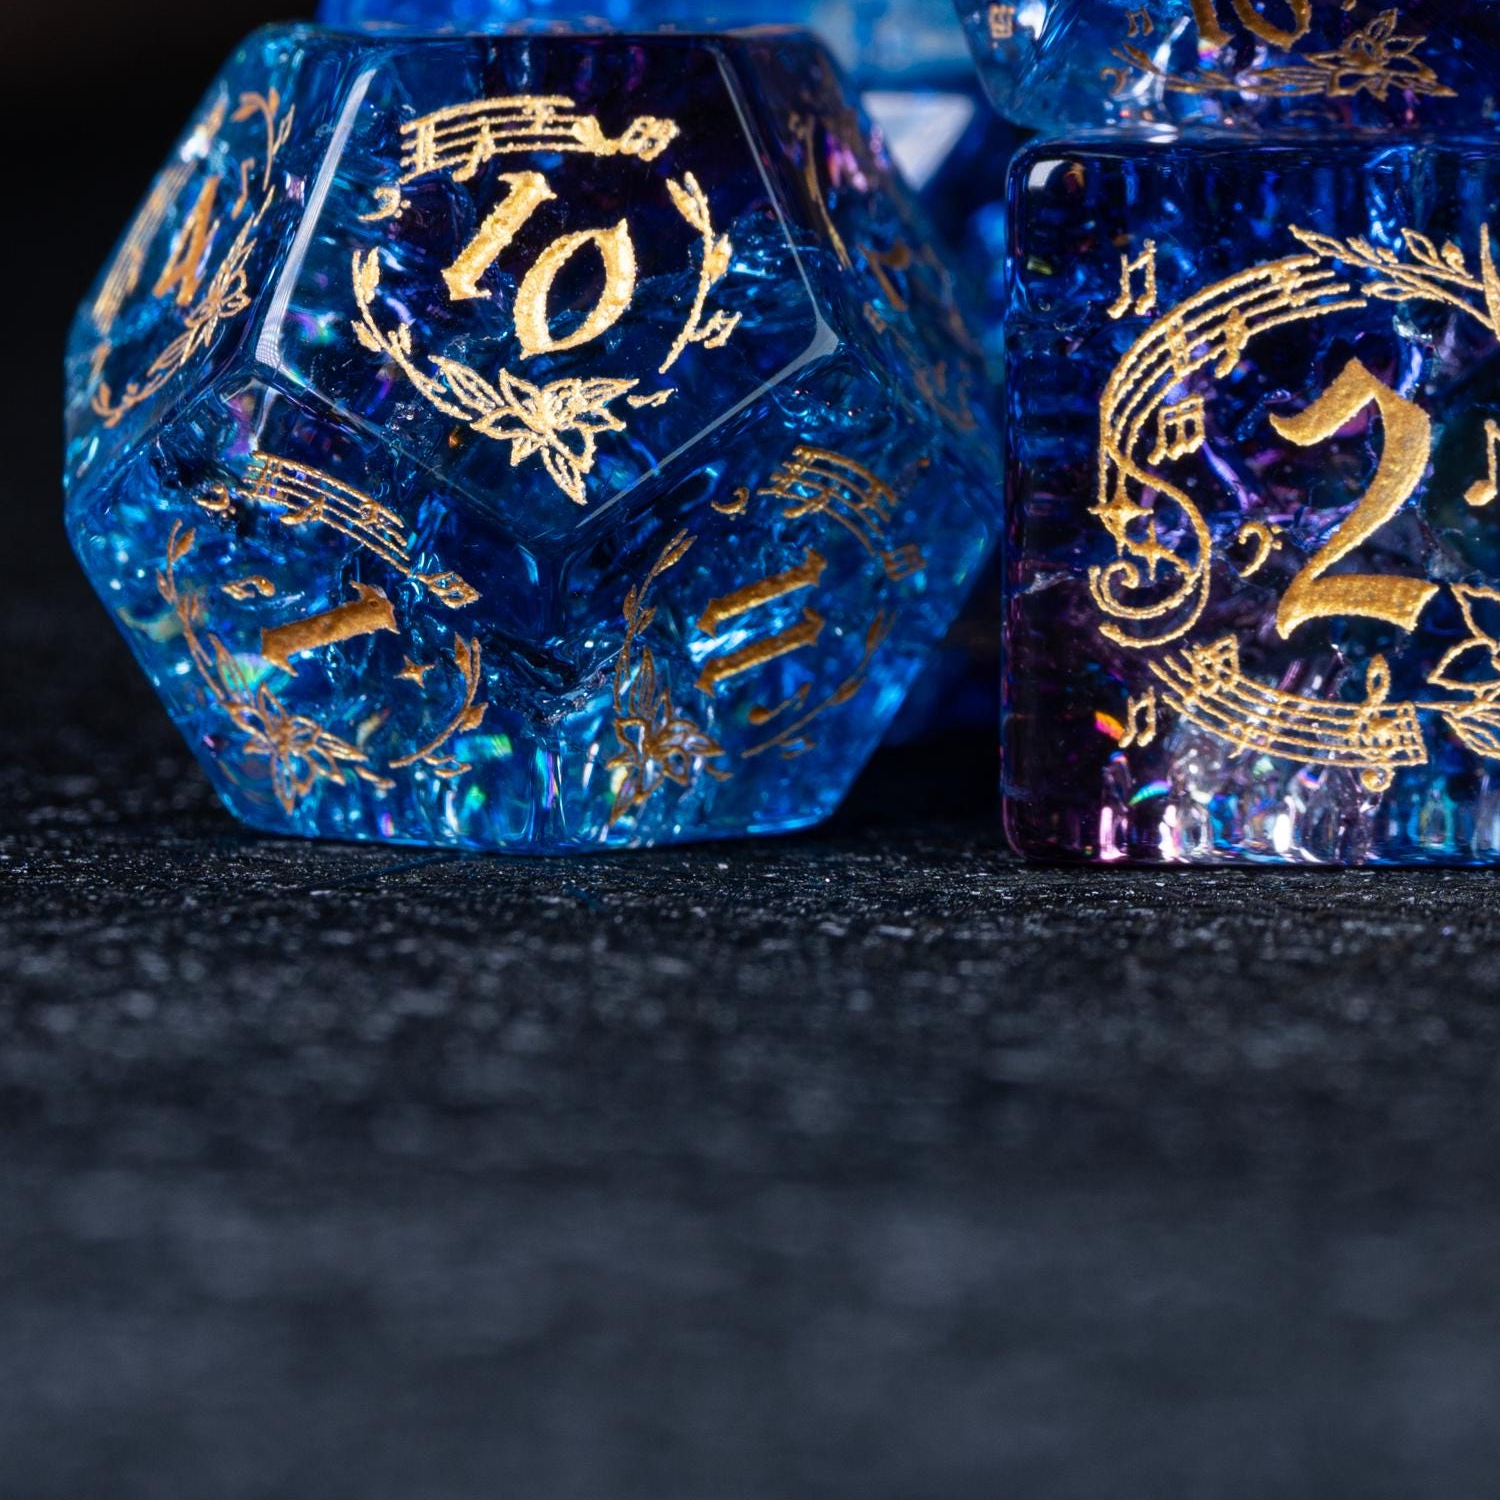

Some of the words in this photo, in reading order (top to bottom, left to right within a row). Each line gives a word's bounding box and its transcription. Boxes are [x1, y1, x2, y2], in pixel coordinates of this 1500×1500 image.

[441, 170, 638, 360] 10
[1268, 356, 1440, 641] 2
[260, 579, 400, 676] 1
[693, 546, 829, 699] 11
